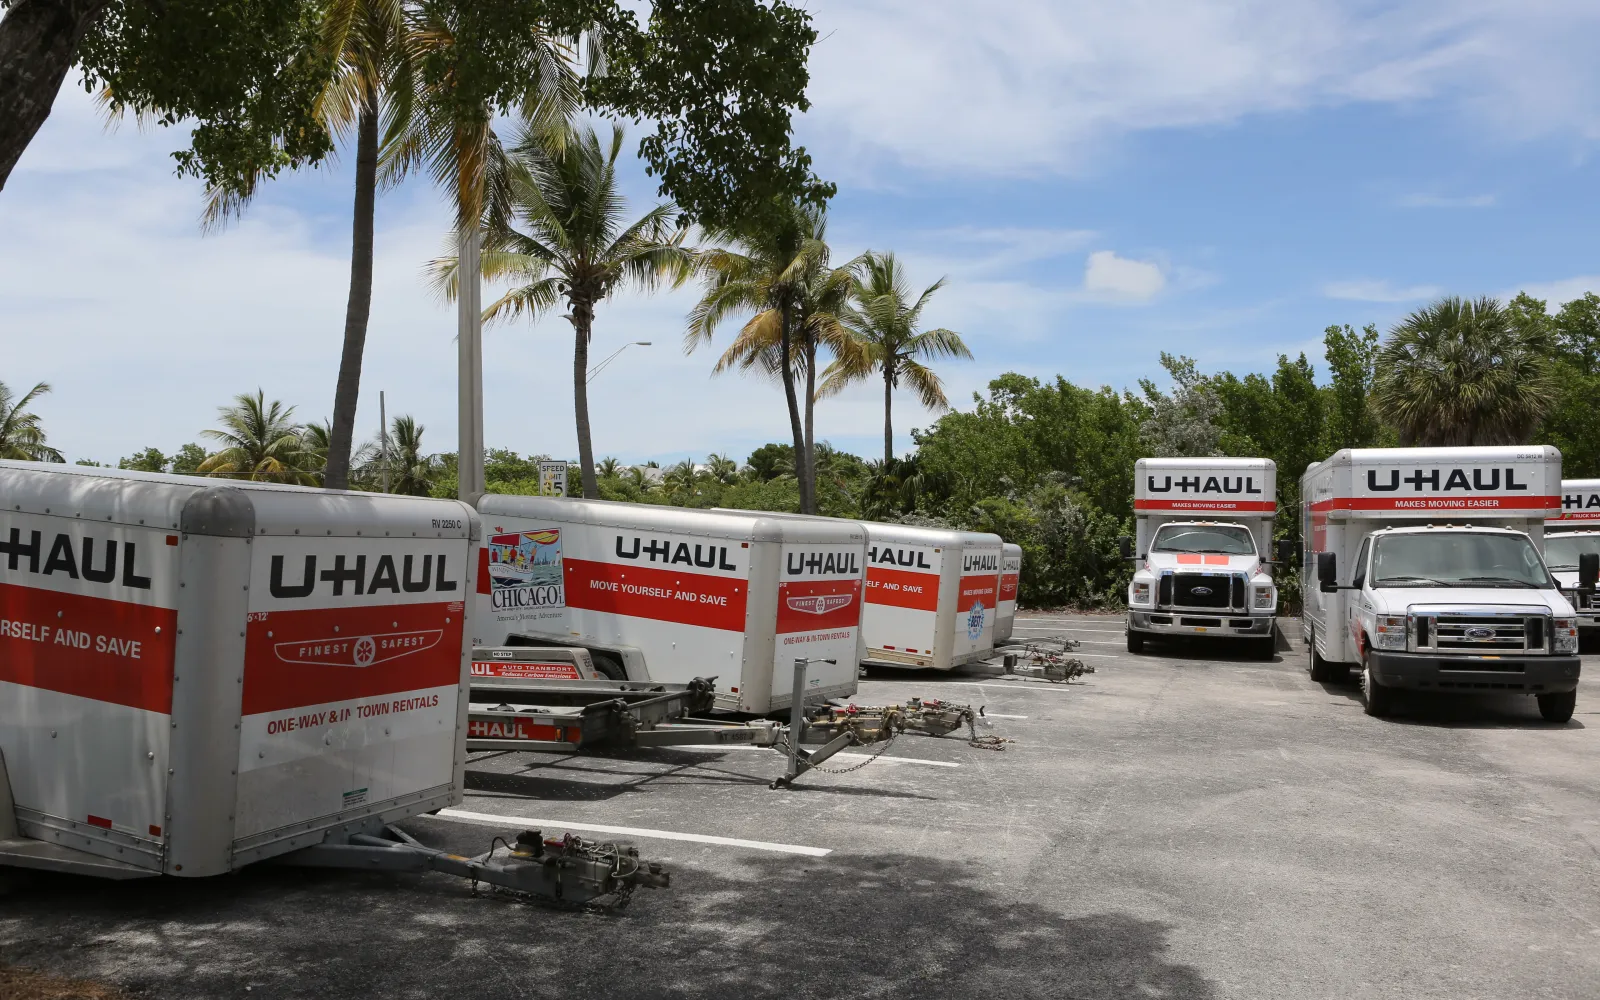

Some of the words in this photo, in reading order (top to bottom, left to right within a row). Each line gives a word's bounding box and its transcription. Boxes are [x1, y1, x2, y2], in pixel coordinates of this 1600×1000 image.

[1148, 476, 1261, 494] U-HAUL
[1368, 468, 1527, 491] U-HAUL
[1395, 500, 1426, 508] MAKES
[1467, 499, 1499, 507] EASIER
[432, 519, 441, 528] RV
[441, 519, 456, 529] 2250
[457, 520, 462, 529] C
[616, 536, 736, 571] U-HAUL
[963, 555, 997, 571] U-HAUL
[787, 553, 859, 575] U-HAUL
[270, 555, 457, 598] U-HAUL
[590, 580, 618, 592] MOVE
[621, 584, 672, 598] YOURSELF
[674, 591, 697, 602] AND
[700, 594, 727, 606] SAVE
[883, 582, 899, 591] AND
[902, 584, 923, 594] SAVE
[54, 629, 91, 649] AND
[95, 635, 141, 659] SAVE
[300, 643, 348, 656] FINEST
[381, 637, 425, 649] SAFEST
[784, 637, 806, 645] ONE-WAY
[830, 631, 850, 640] RENTALS
[267, 711, 326, 735] ONE-WAY
[329, 711, 338, 723] &
[357, 702, 390, 719] TOWN
[392, 694, 439, 713] RENTALS
[467, 722, 528, 739] -HAUL
